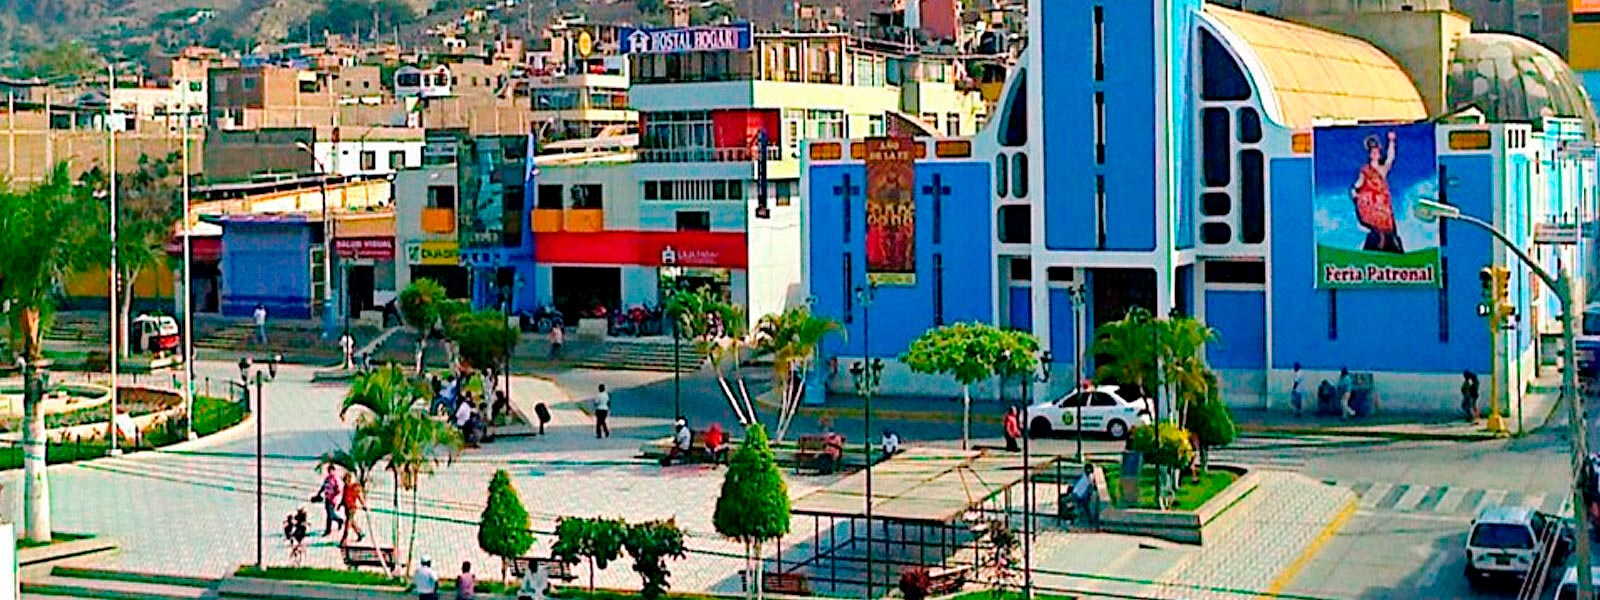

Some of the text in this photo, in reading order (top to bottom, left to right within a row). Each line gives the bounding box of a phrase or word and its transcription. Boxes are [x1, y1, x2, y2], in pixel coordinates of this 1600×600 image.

[652, 29, 738, 51] HOSTAL HOGAR
[363, 240, 392, 248] VISUAL
[1325, 265, 1433, 282] Feria Patronal
